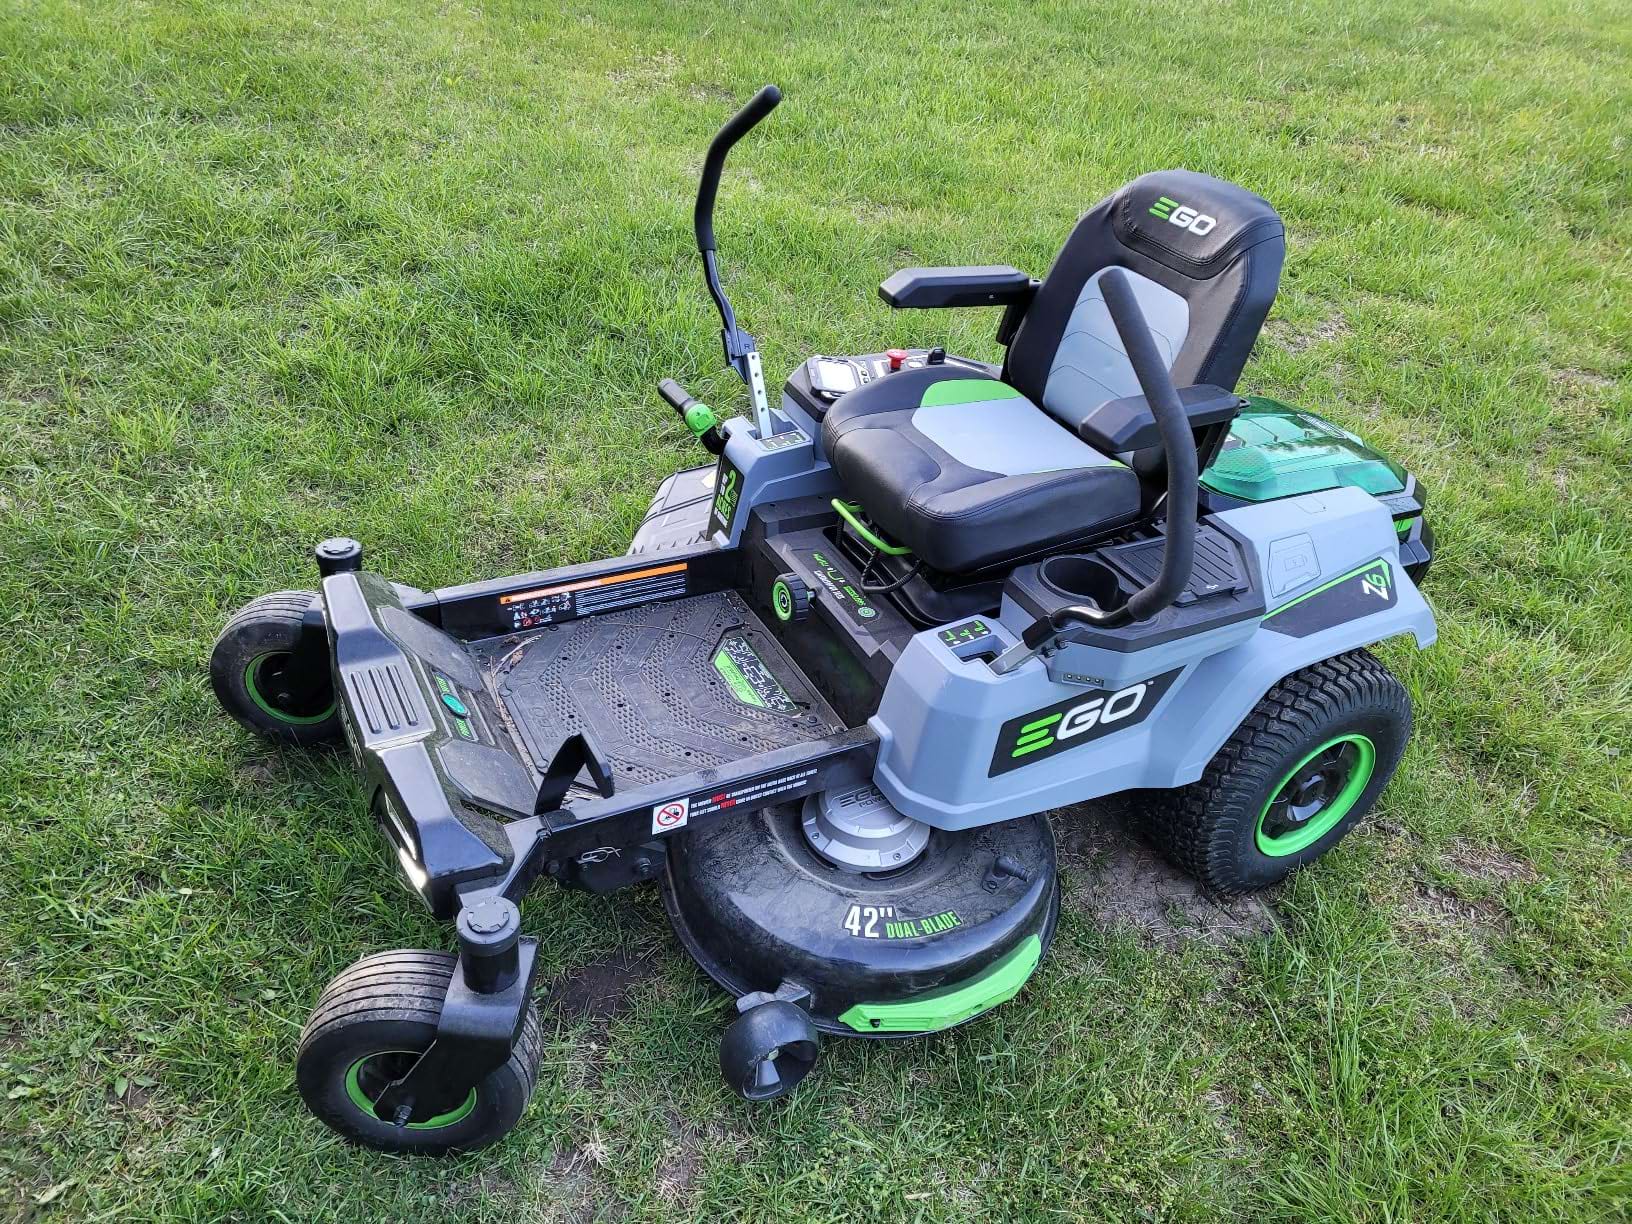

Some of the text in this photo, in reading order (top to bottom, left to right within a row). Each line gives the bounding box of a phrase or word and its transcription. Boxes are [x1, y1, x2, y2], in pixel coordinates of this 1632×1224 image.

[1149, 196, 1217, 236] EGO
[1361, 572, 1389, 601] Z6
[1011, 683, 1147, 758] EGO
[844, 905, 894, 938] 42"
